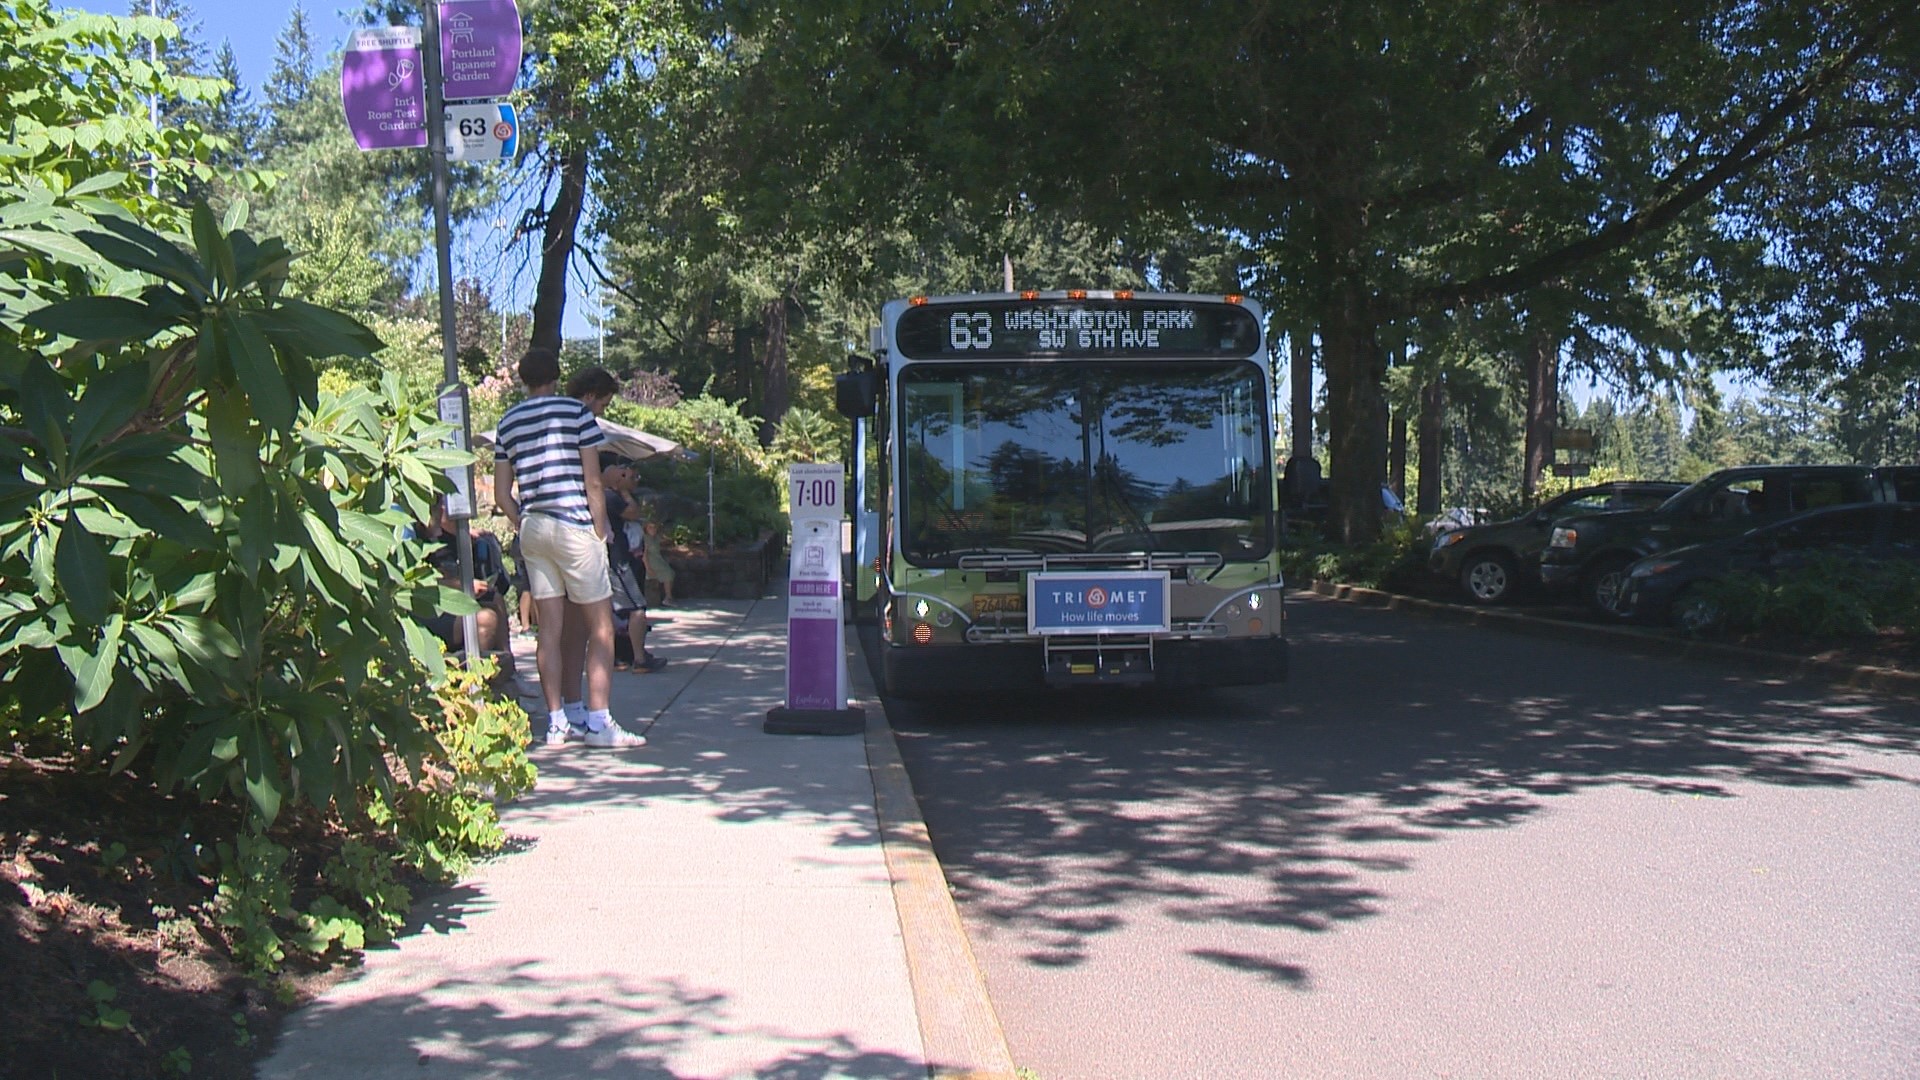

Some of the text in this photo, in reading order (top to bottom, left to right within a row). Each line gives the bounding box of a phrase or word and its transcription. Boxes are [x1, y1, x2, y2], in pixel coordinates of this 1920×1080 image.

[356, 37, 412, 47] FREE SHUTTLE
[451, 47, 496, 58] Portland
[452, 60, 497, 72] Japanese
[452, 71, 490, 81] Garden
[394, 96, 416, 106] Int'l
[367, 110, 417, 120] Rose Test
[379, 120, 417, 131] Garden
[459, 117, 487, 137] 63
[1004, 310, 1195, 330] WASHINGTON PARK
[949, 312, 993, 350] 63
[1038, 329, 1160, 349] SW 6TH AVE
[795, 479, 836, 507] 7:00
[815, 583, 832, 594] HERE
[1061, 611, 1140, 622] How life moves
